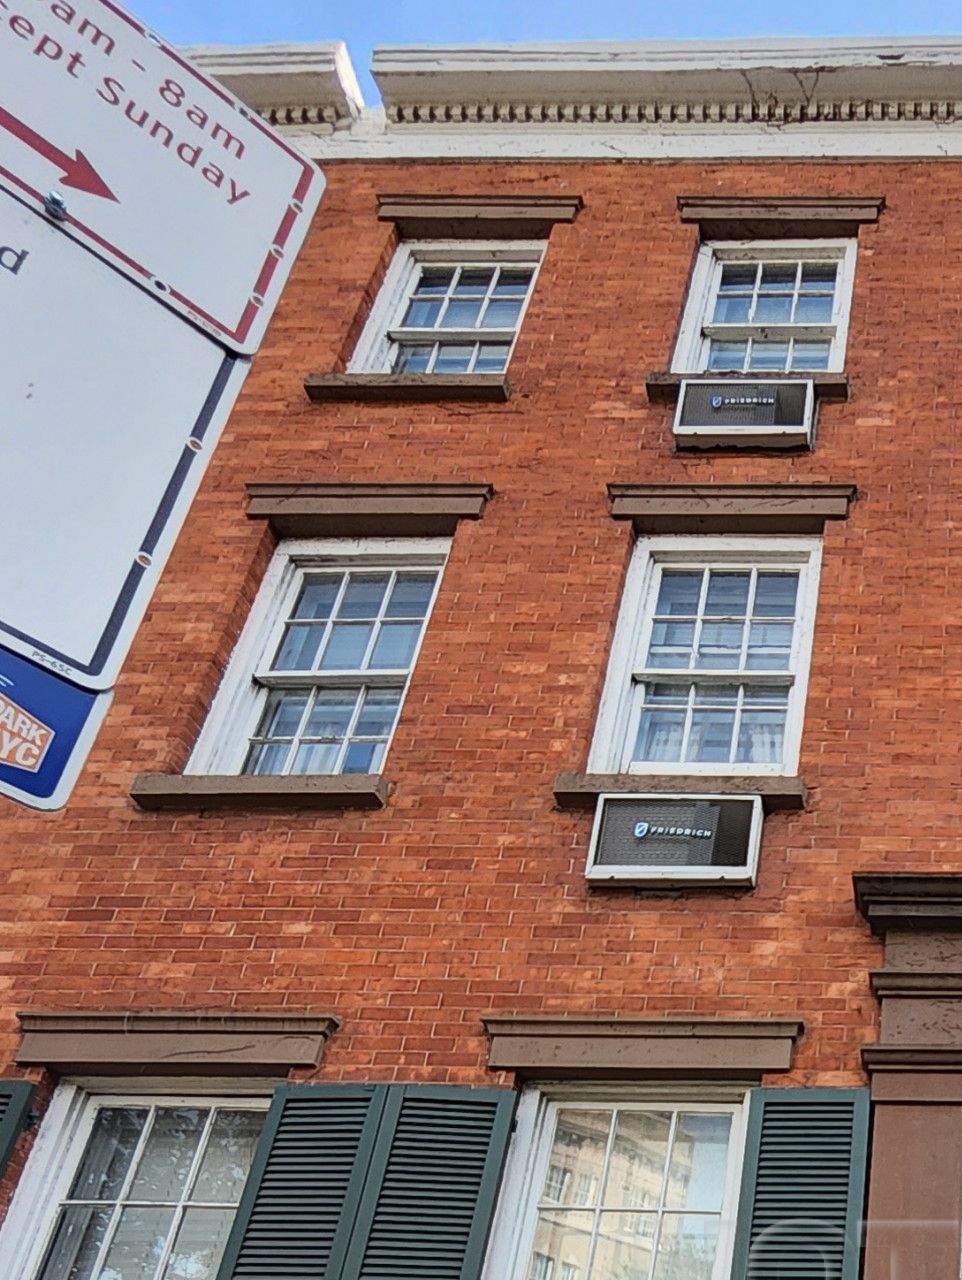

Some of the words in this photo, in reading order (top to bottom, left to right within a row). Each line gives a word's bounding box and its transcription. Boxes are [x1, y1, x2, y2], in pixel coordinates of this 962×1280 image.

[0, 0, 87, 79] ept
[96, 77, 251, 205] Sunday
[159, 79, 246, 161] 8am
[650, 826, 712, 837] FRIEDRICH
